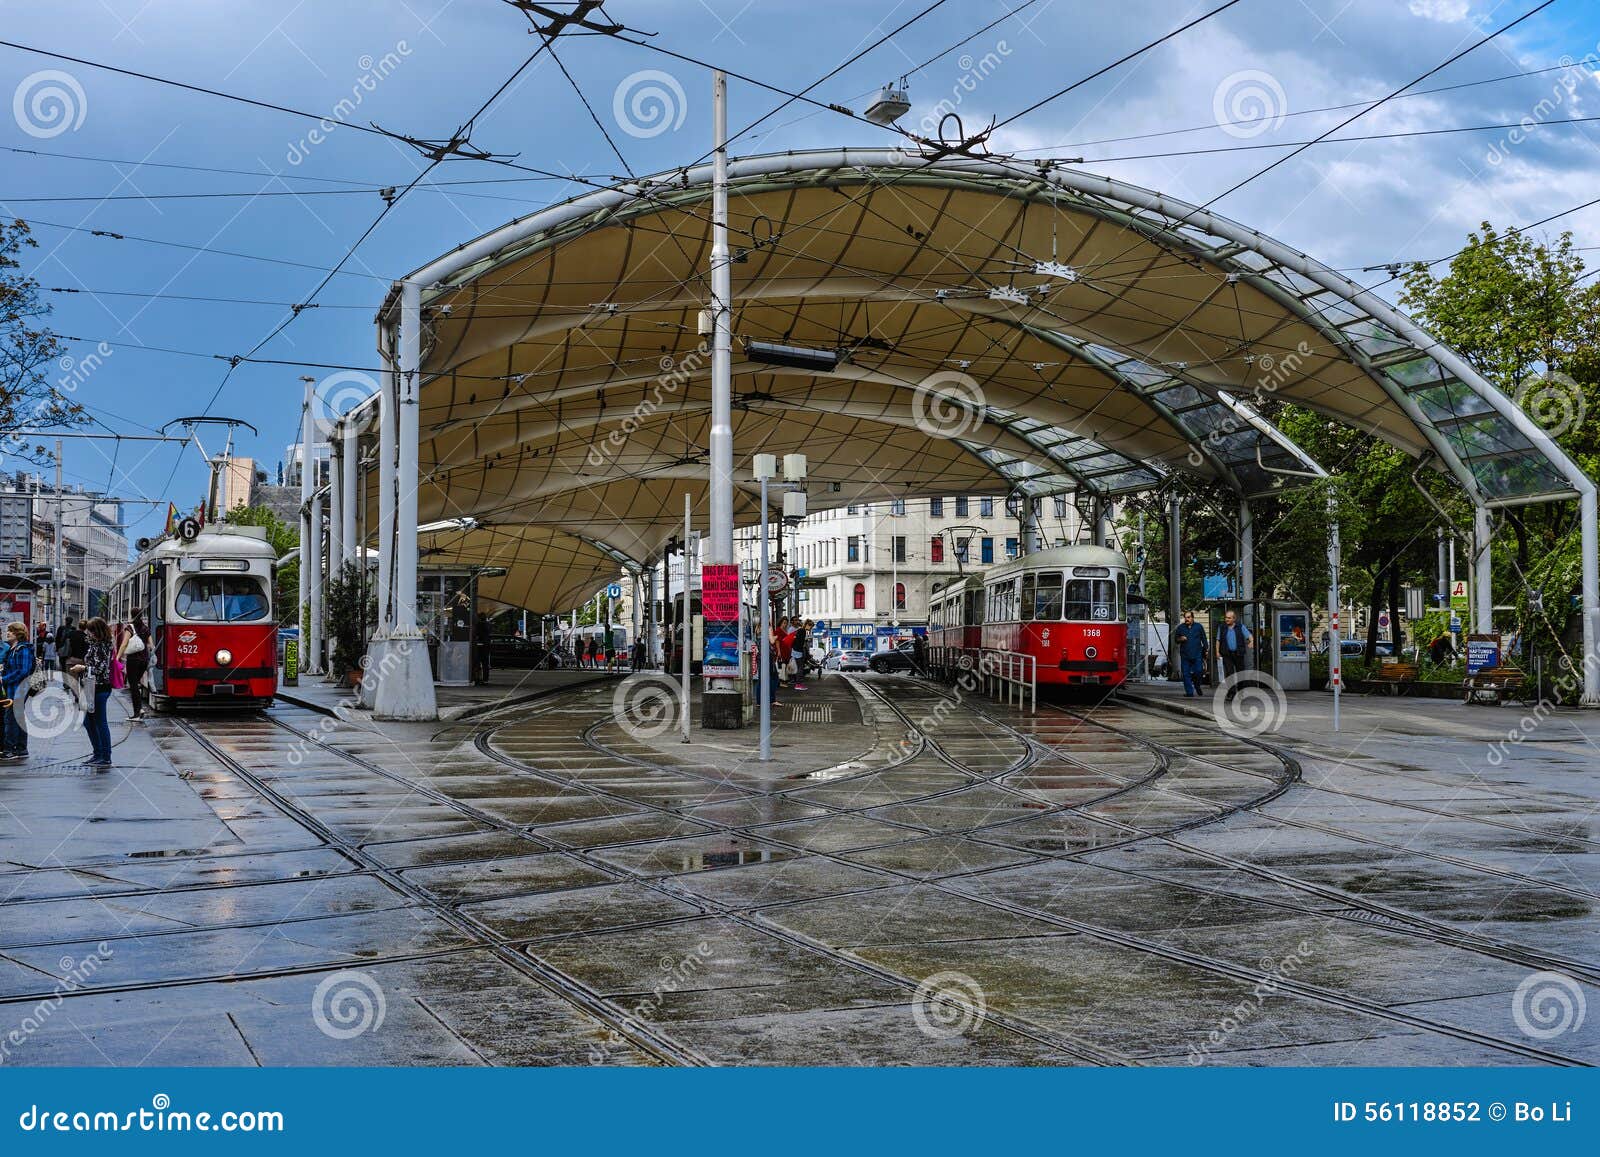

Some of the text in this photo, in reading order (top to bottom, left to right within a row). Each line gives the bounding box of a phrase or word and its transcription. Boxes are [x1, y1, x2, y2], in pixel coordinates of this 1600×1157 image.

[184, 520, 195, 538] 6
[611, 587, 619, 597] U
[1453, 582, 1464, 596] A
[1093, 607, 1108, 618] 49
[841, 624, 873, 635] HANDYLAND
[1082, 629, 1101, 637] 1368
[177, 645, 198, 654] 4522
